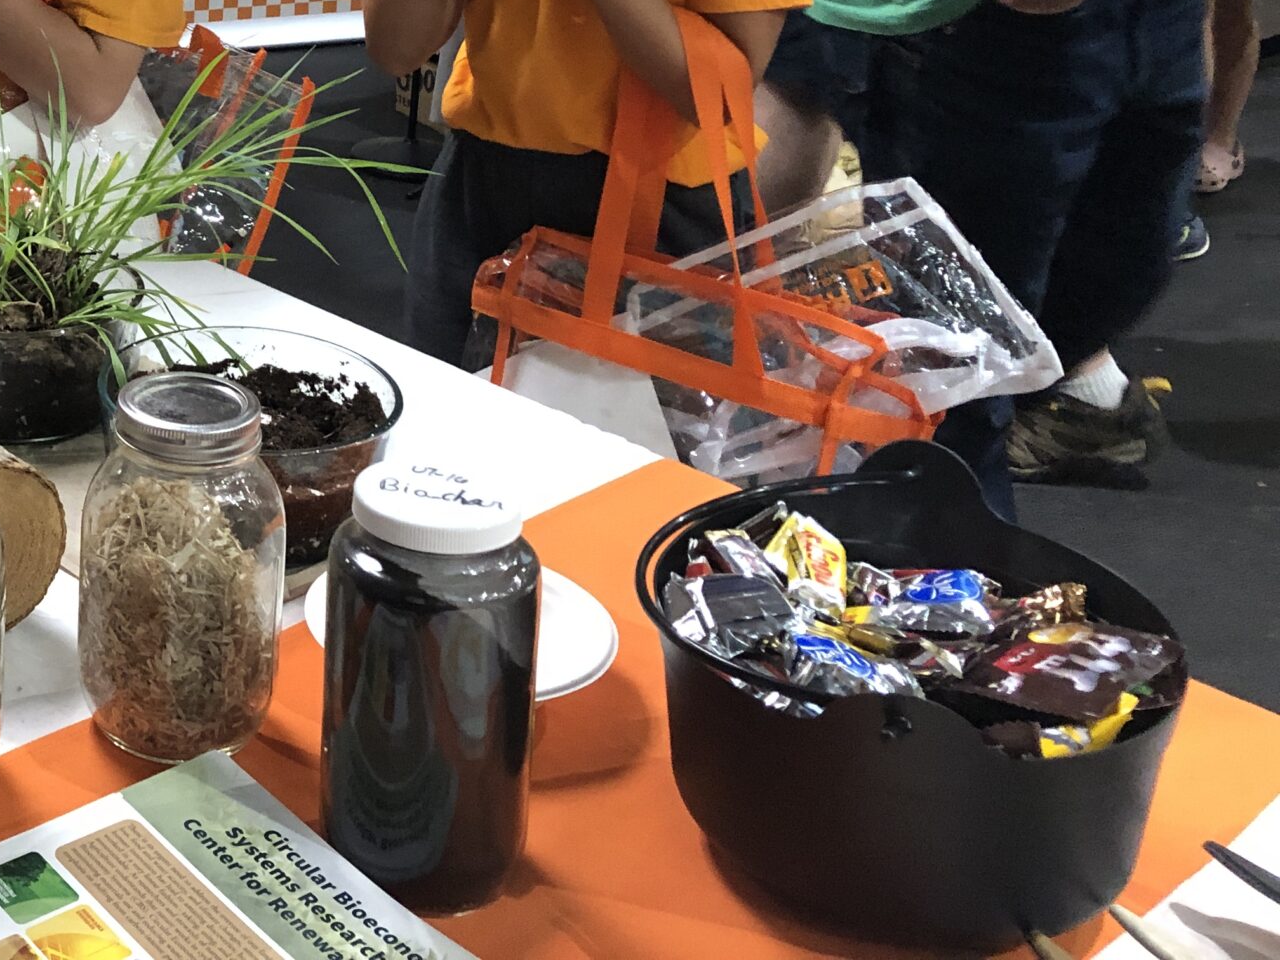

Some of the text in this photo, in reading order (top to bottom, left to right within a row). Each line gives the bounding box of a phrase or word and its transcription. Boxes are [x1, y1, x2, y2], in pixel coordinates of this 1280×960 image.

[183, 817, 245, 872] Center
[238, 869, 273, 898] for
[267, 895, 355, 960] Renewa
[225, 825, 302, 894] Systems
[263, 828, 338, 892] Circular
